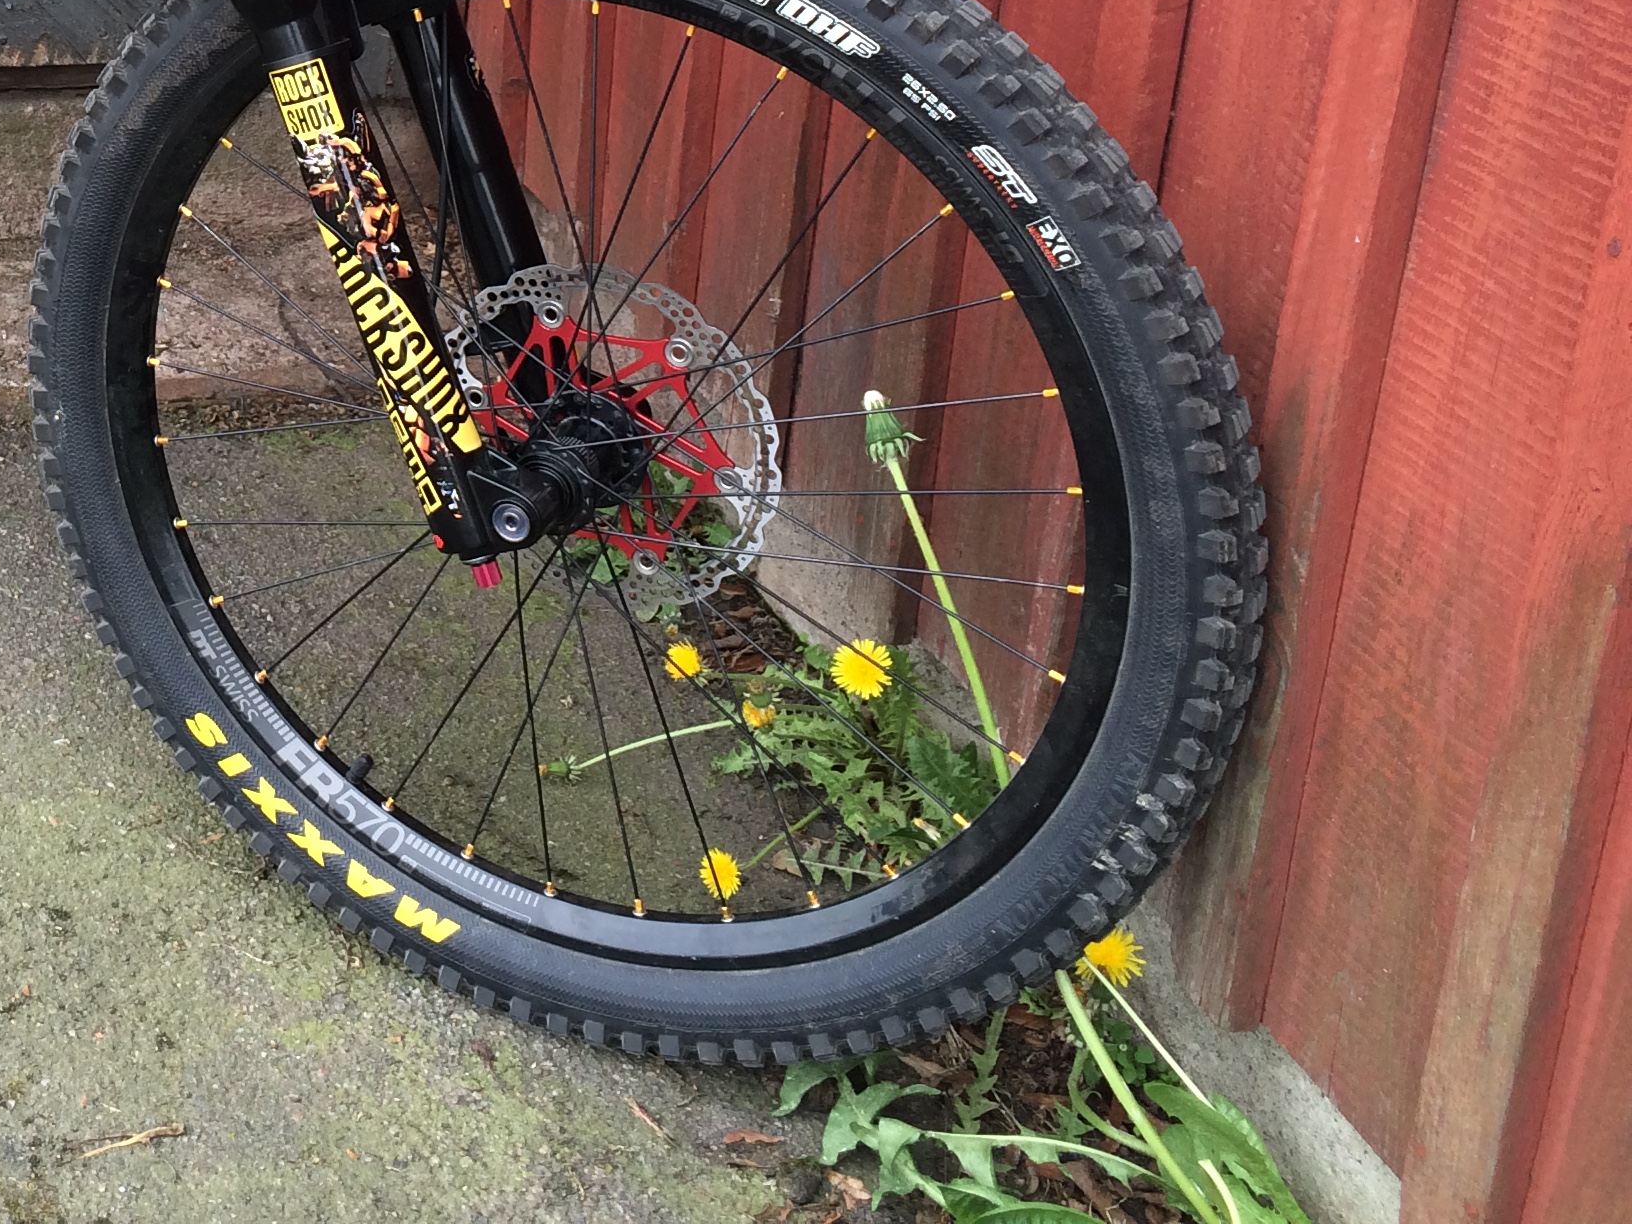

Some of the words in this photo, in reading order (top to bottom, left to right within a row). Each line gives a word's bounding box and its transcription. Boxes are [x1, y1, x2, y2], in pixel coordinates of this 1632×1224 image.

[273, 65, 326, 103] ROCK
[902, 73, 956, 121] 26X2.50
[287, 100, 336, 135] SHOX
[921, 102, 941, 121] PSI
[1032, 216, 1080, 268] EXO
[330, 239, 469, 439] ROCKSHOX
[186, 629, 218, 662] DT
[214, 664, 260, 724] SWISS
[276, 737, 408, 858] FR570
[184, 711, 462, 944] MAXXIS
